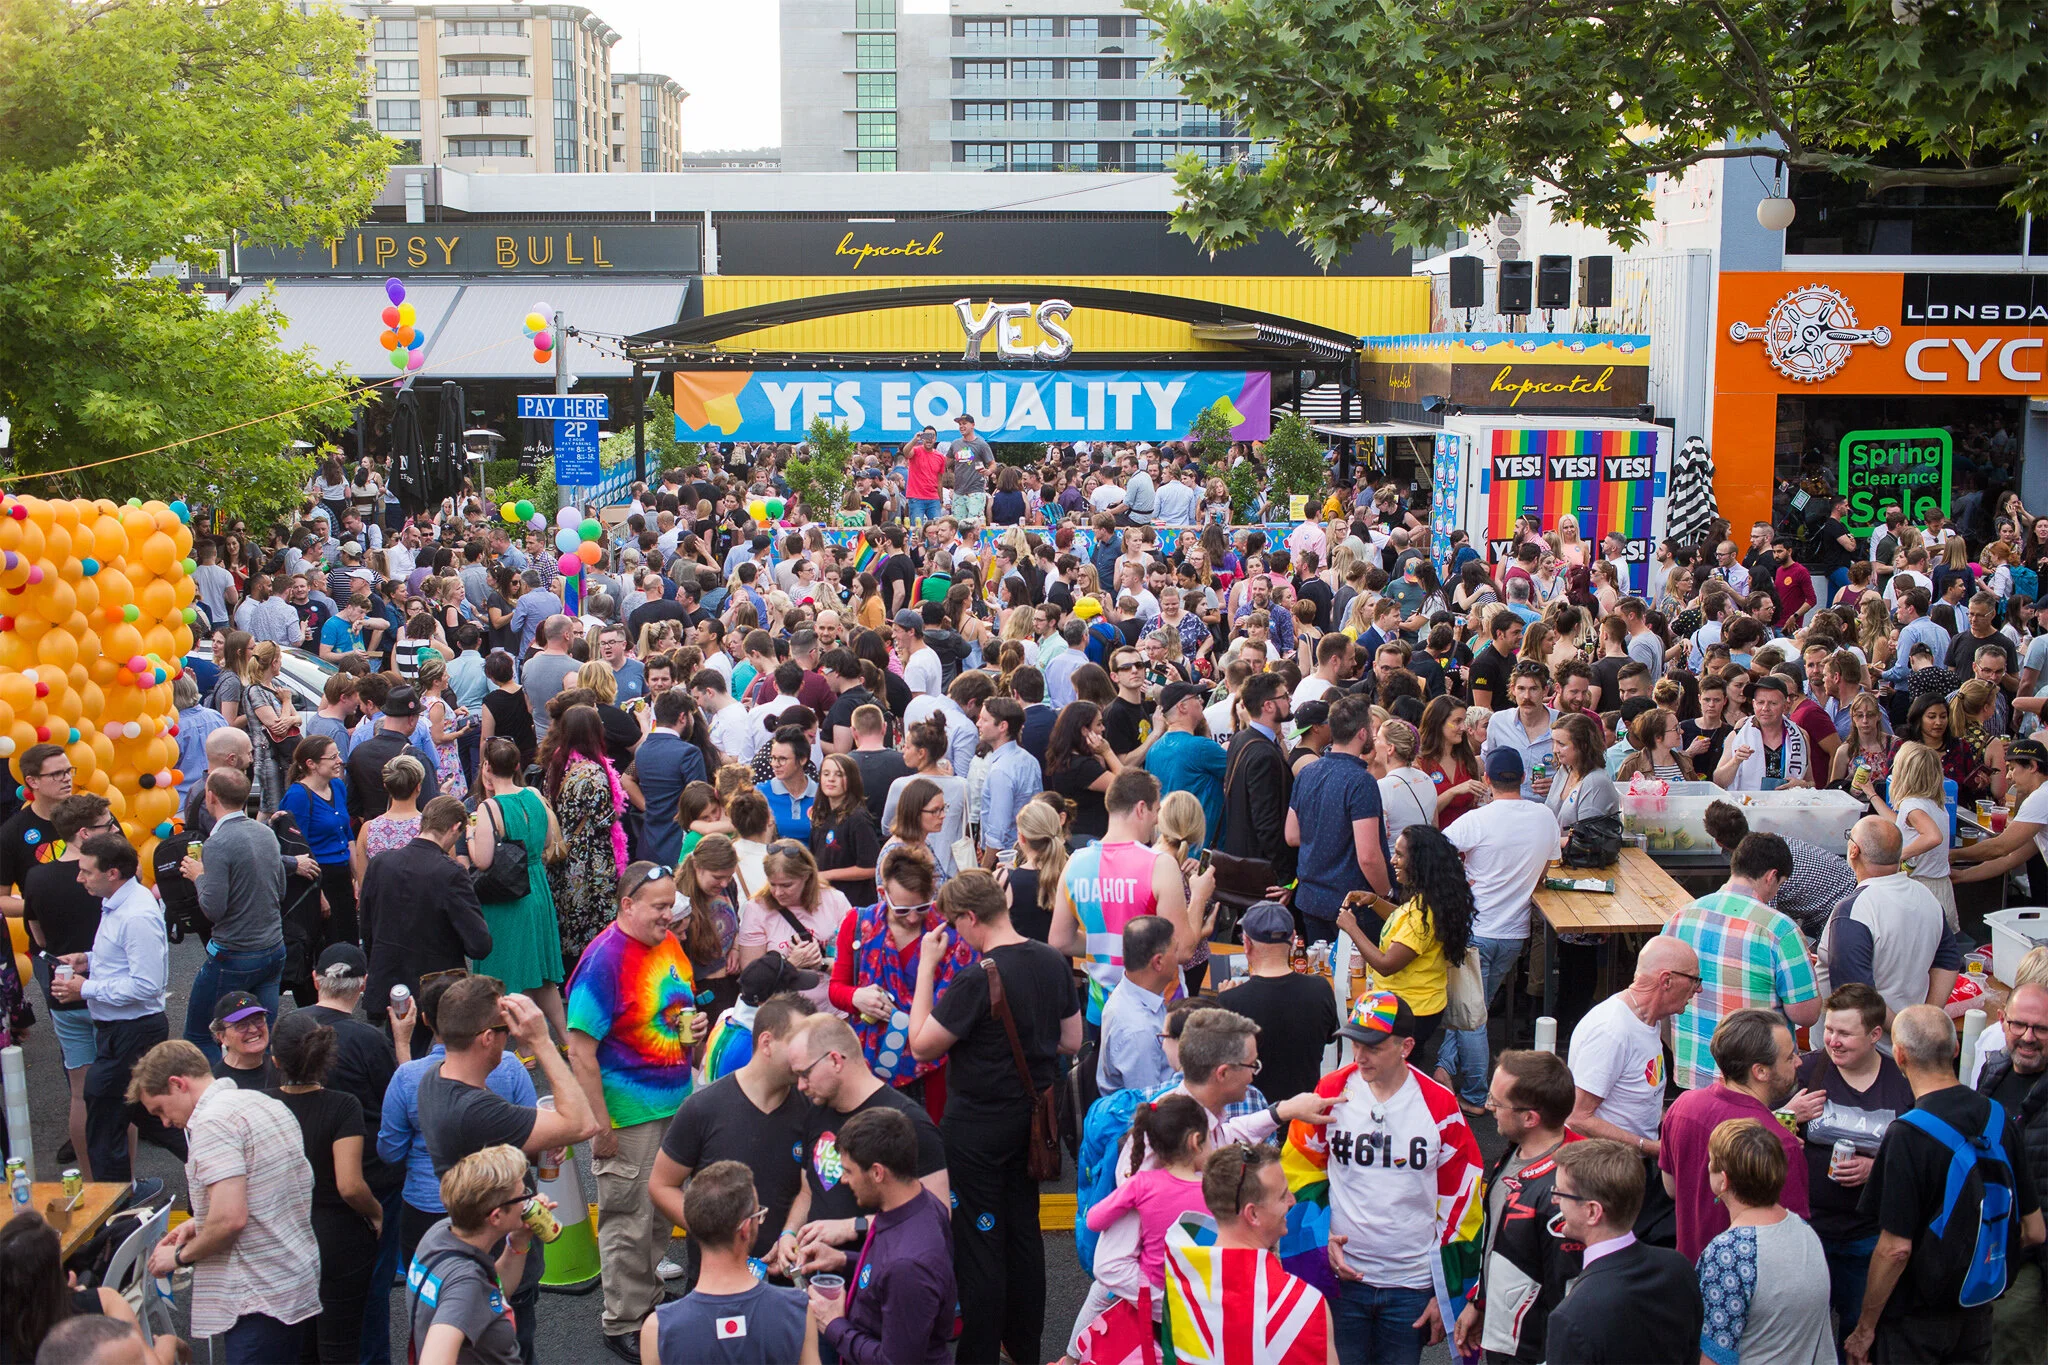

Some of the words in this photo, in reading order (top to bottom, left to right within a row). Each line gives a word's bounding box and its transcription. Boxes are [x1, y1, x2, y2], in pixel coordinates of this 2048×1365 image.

[330, 233, 460, 268] TIPSY
[497, 232, 613, 268] BULL
[836, 232, 944, 270] hopscotch
[1907, 304, 2048, 320] LONSDA
[953, 298, 1074, 362] YES
[1490, 365, 1615, 407] hopscotch
[524, 398, 556, 417] PAY
[564, 399, 605, 418] HERE
[760, 381, 865, 431] YES
[881, 381, 1187, 431] EQUALITY
[564, 421, 588, 438] 2P
[1495, 456, 1541, 478] YES!
[1852, 442, 1940, 469] Spring
[1550, 456, 1596, 479] YES!
[1605, 456, 1650, 479] YES!
[1852, 471, 1939, 486] Clearance
[1073, 877, 1138, 904] IDAHOT
[817, 1158, 845, 1179] YES
